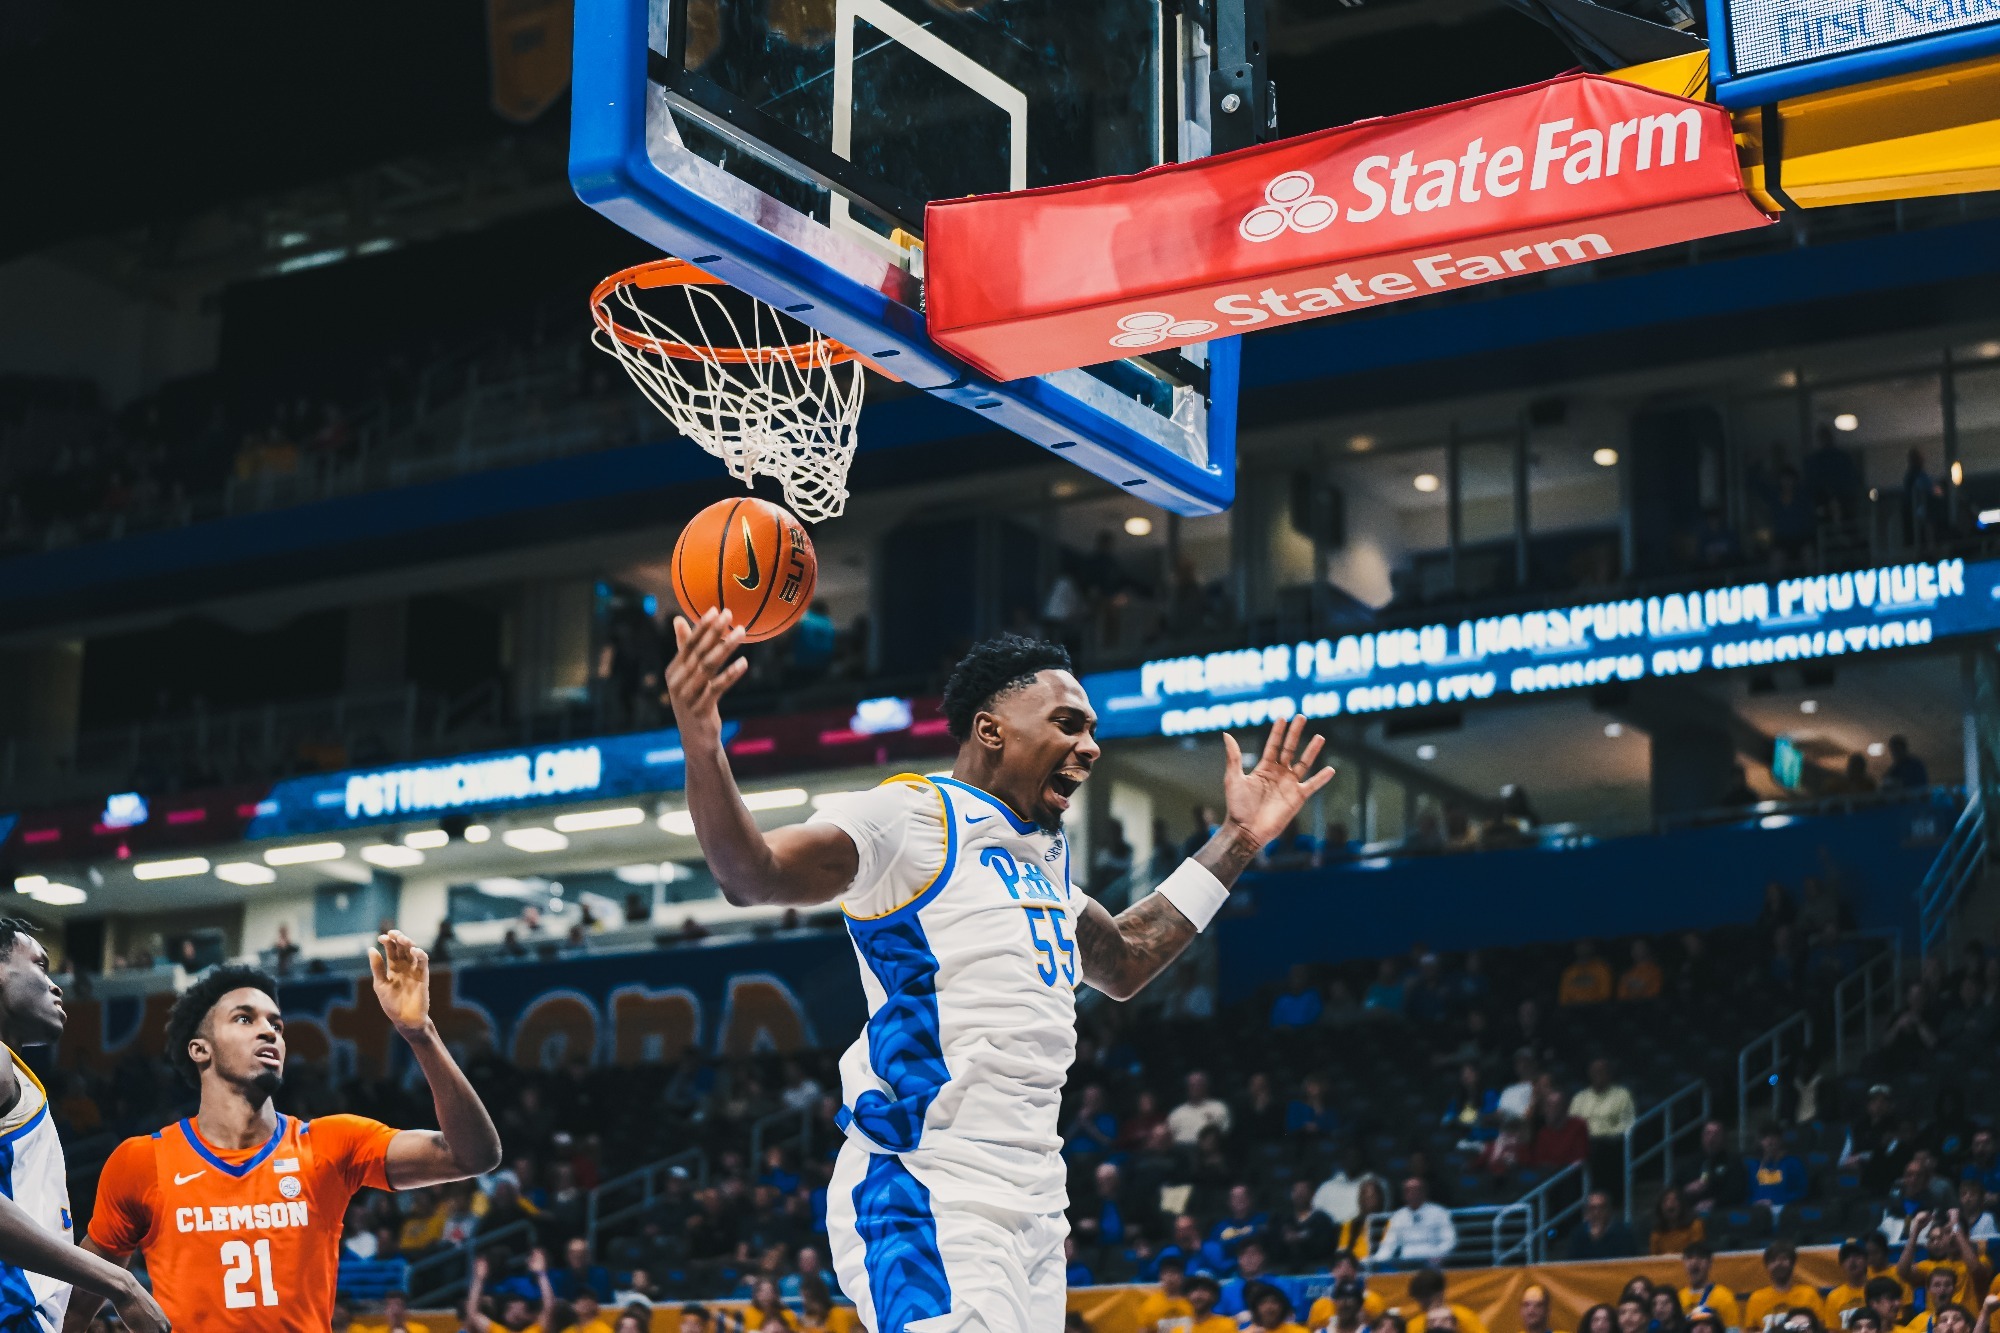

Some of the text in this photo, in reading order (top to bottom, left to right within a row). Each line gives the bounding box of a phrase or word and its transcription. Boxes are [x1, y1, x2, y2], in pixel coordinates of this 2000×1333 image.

[1779, 4, 1874, 54] First
[778, 527, 806, 605] ELITE
[980, 846, 1061, 902] Pitt
[1022, 904, 1076, 990] 55
[175, 1200, 309, 1233] CLEMSON
[220, 1238, 279, 1309] 21
